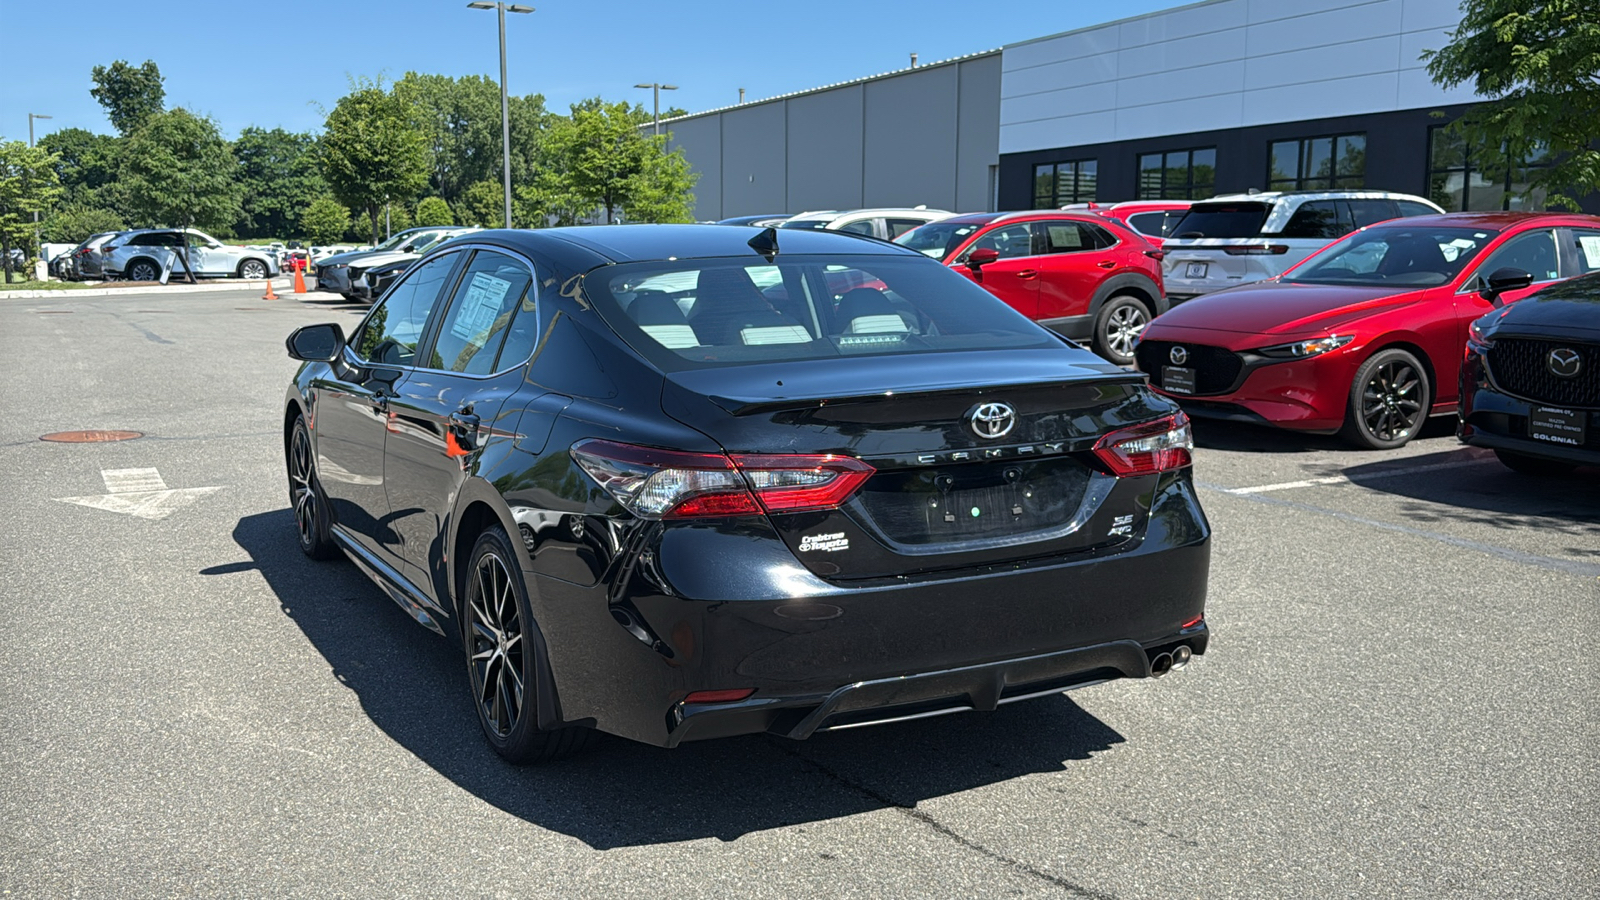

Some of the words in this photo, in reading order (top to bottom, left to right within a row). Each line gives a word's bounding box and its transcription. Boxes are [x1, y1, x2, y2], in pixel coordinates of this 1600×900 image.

[1532, 420, 1554, 429] CERTIFIED
[1533, 433, 1578, 445] COLONIAL
[918, 442, 1064, 463] CAMRY
[1113, 514, 1134, 527] SE
[1107, 525, 1132, 536] AWD
[801, 532, 845, 544] Crabtree
[810, 538, 849, 551] Toyota
